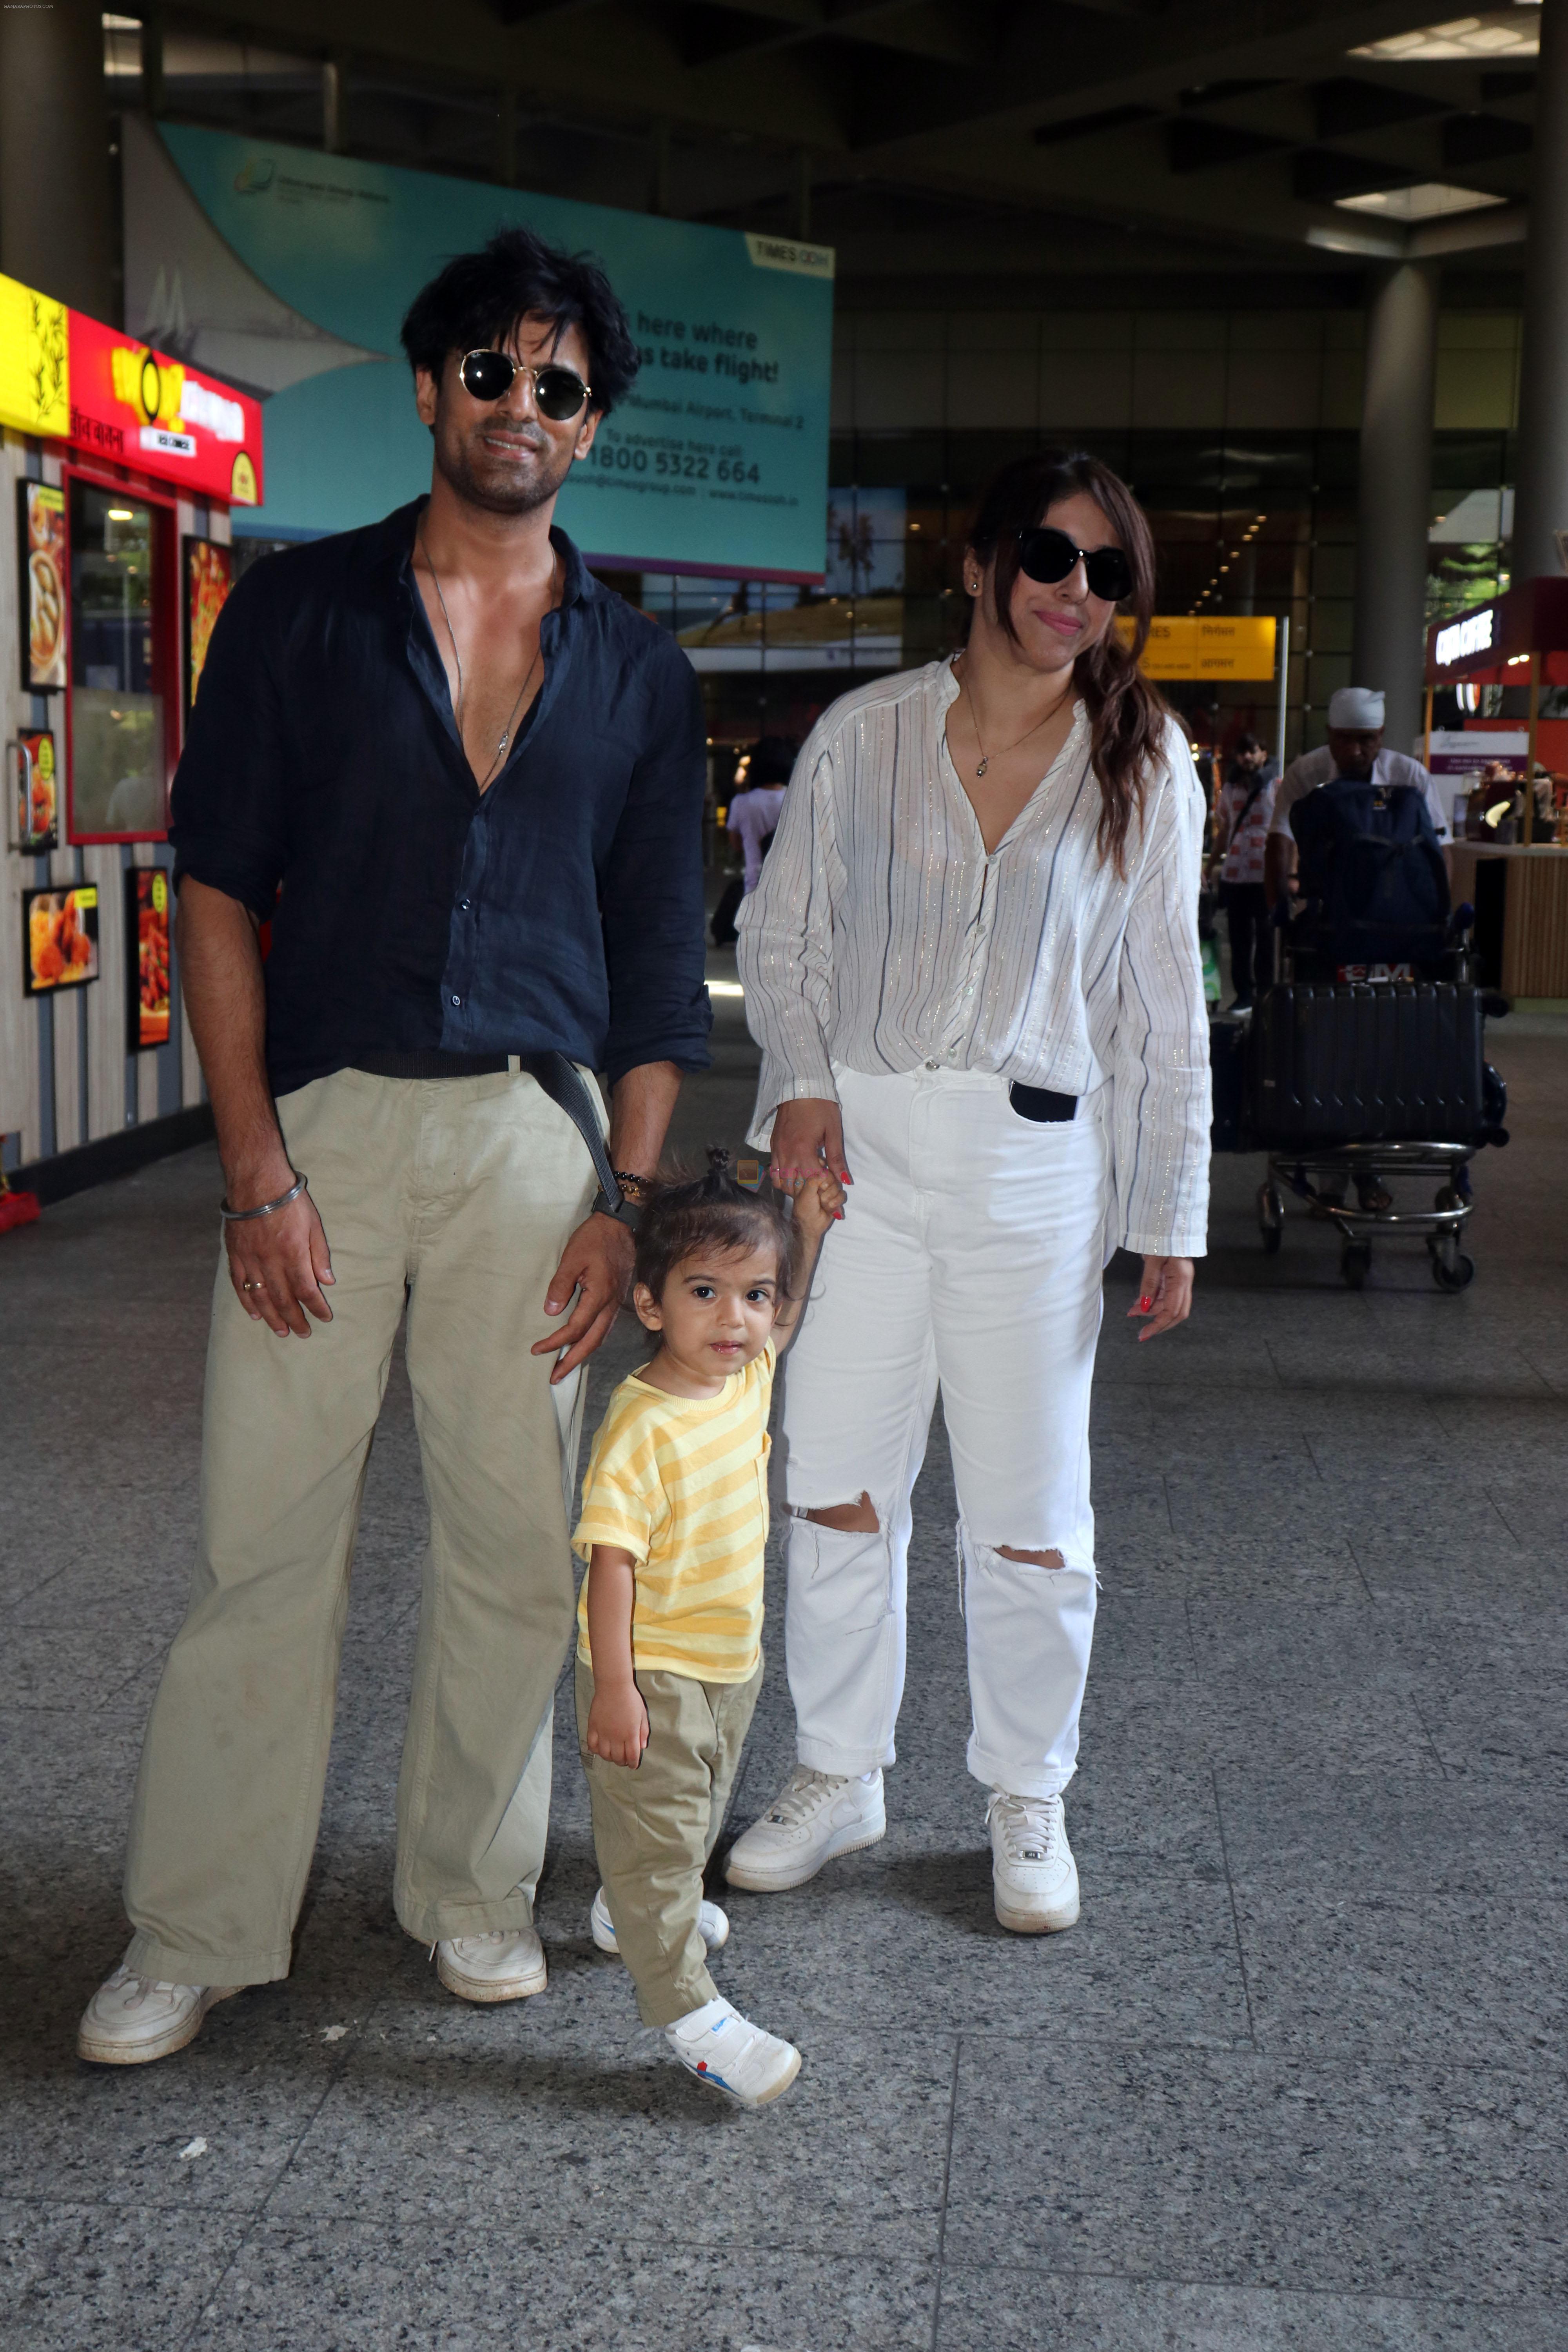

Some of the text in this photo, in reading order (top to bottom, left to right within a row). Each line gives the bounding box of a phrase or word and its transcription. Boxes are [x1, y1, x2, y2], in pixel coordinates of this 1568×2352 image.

[757, 241, 796, 261] TIMES
[637, 311, 757, 349] here where
[661, 347, 708, 373] take
[715, 353, 779, 385] flight!
[740, 407, 792, 427] Terminal
[796, 415, 804, 429] 2
[589, 444, 760, 484] 1800 5322 664
